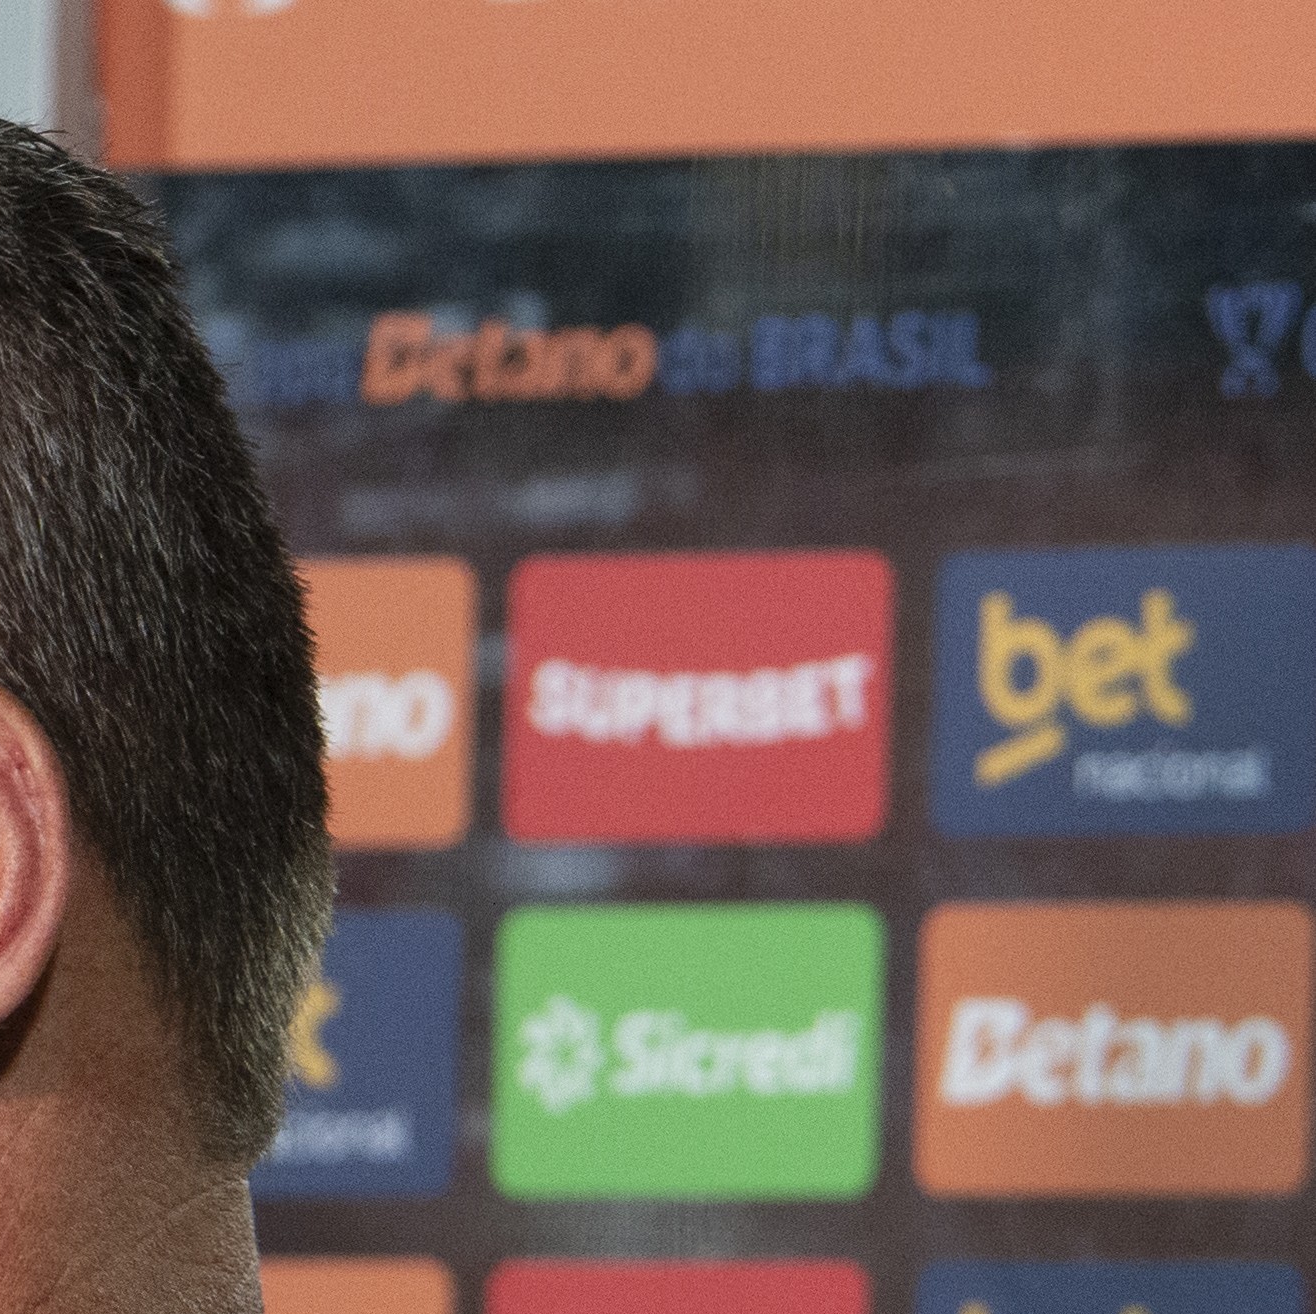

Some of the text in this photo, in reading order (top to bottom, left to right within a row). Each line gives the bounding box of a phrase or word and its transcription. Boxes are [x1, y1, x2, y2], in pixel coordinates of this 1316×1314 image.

[753, 312, 990, 390] BRASIL
[530, 654, 871, 747] SUPERBET
[978, 590, 1196, 727] bet
[613, 1008, 863, 1096] Sicredi
[939, 997, 1292, 1107] Betano
